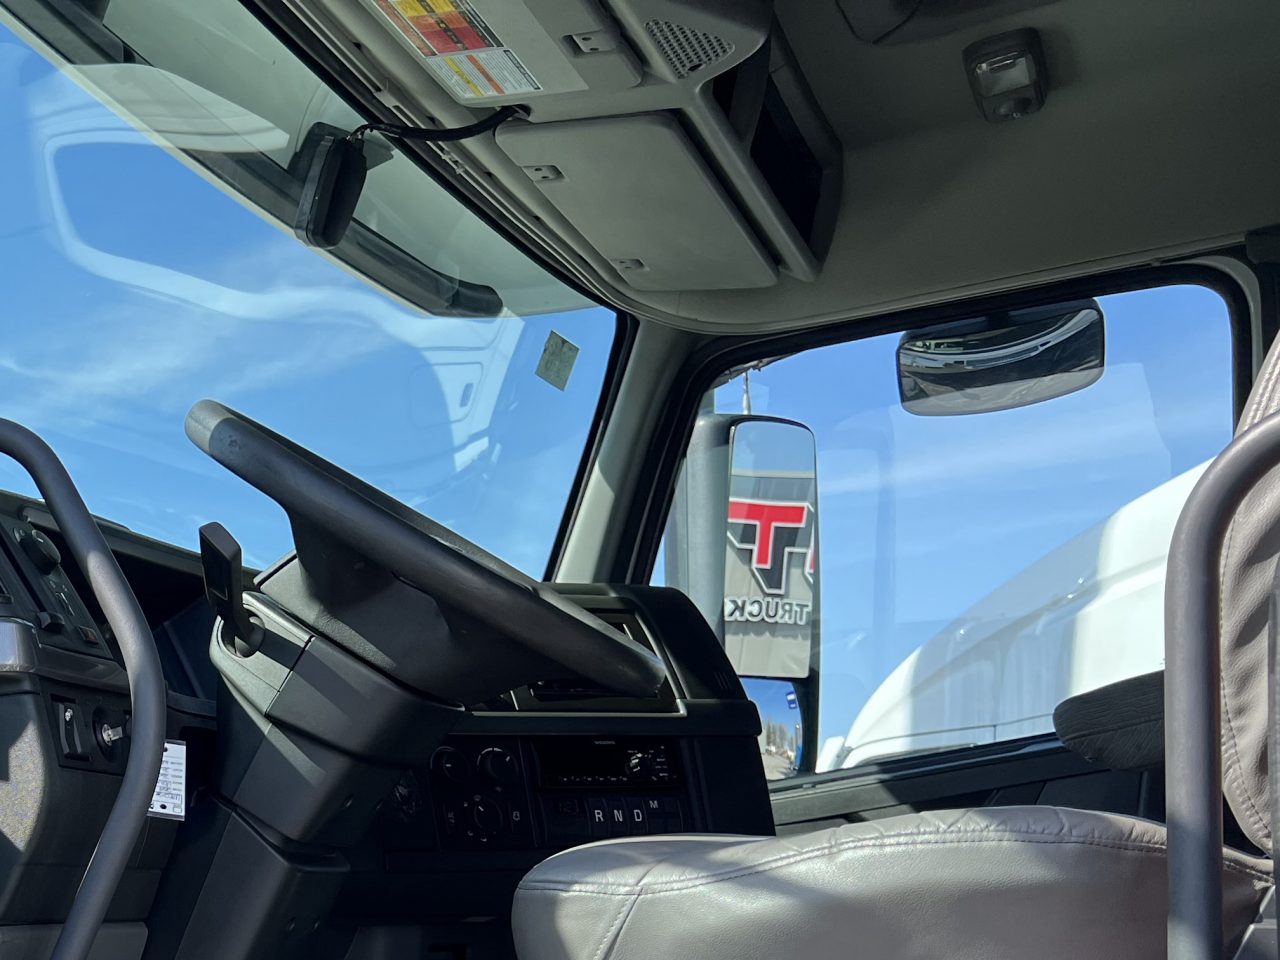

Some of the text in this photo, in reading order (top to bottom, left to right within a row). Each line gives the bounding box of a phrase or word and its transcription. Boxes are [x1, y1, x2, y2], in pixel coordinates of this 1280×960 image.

[649, 800, 658, 808] M
[594, 809, 642, 822] R N D
